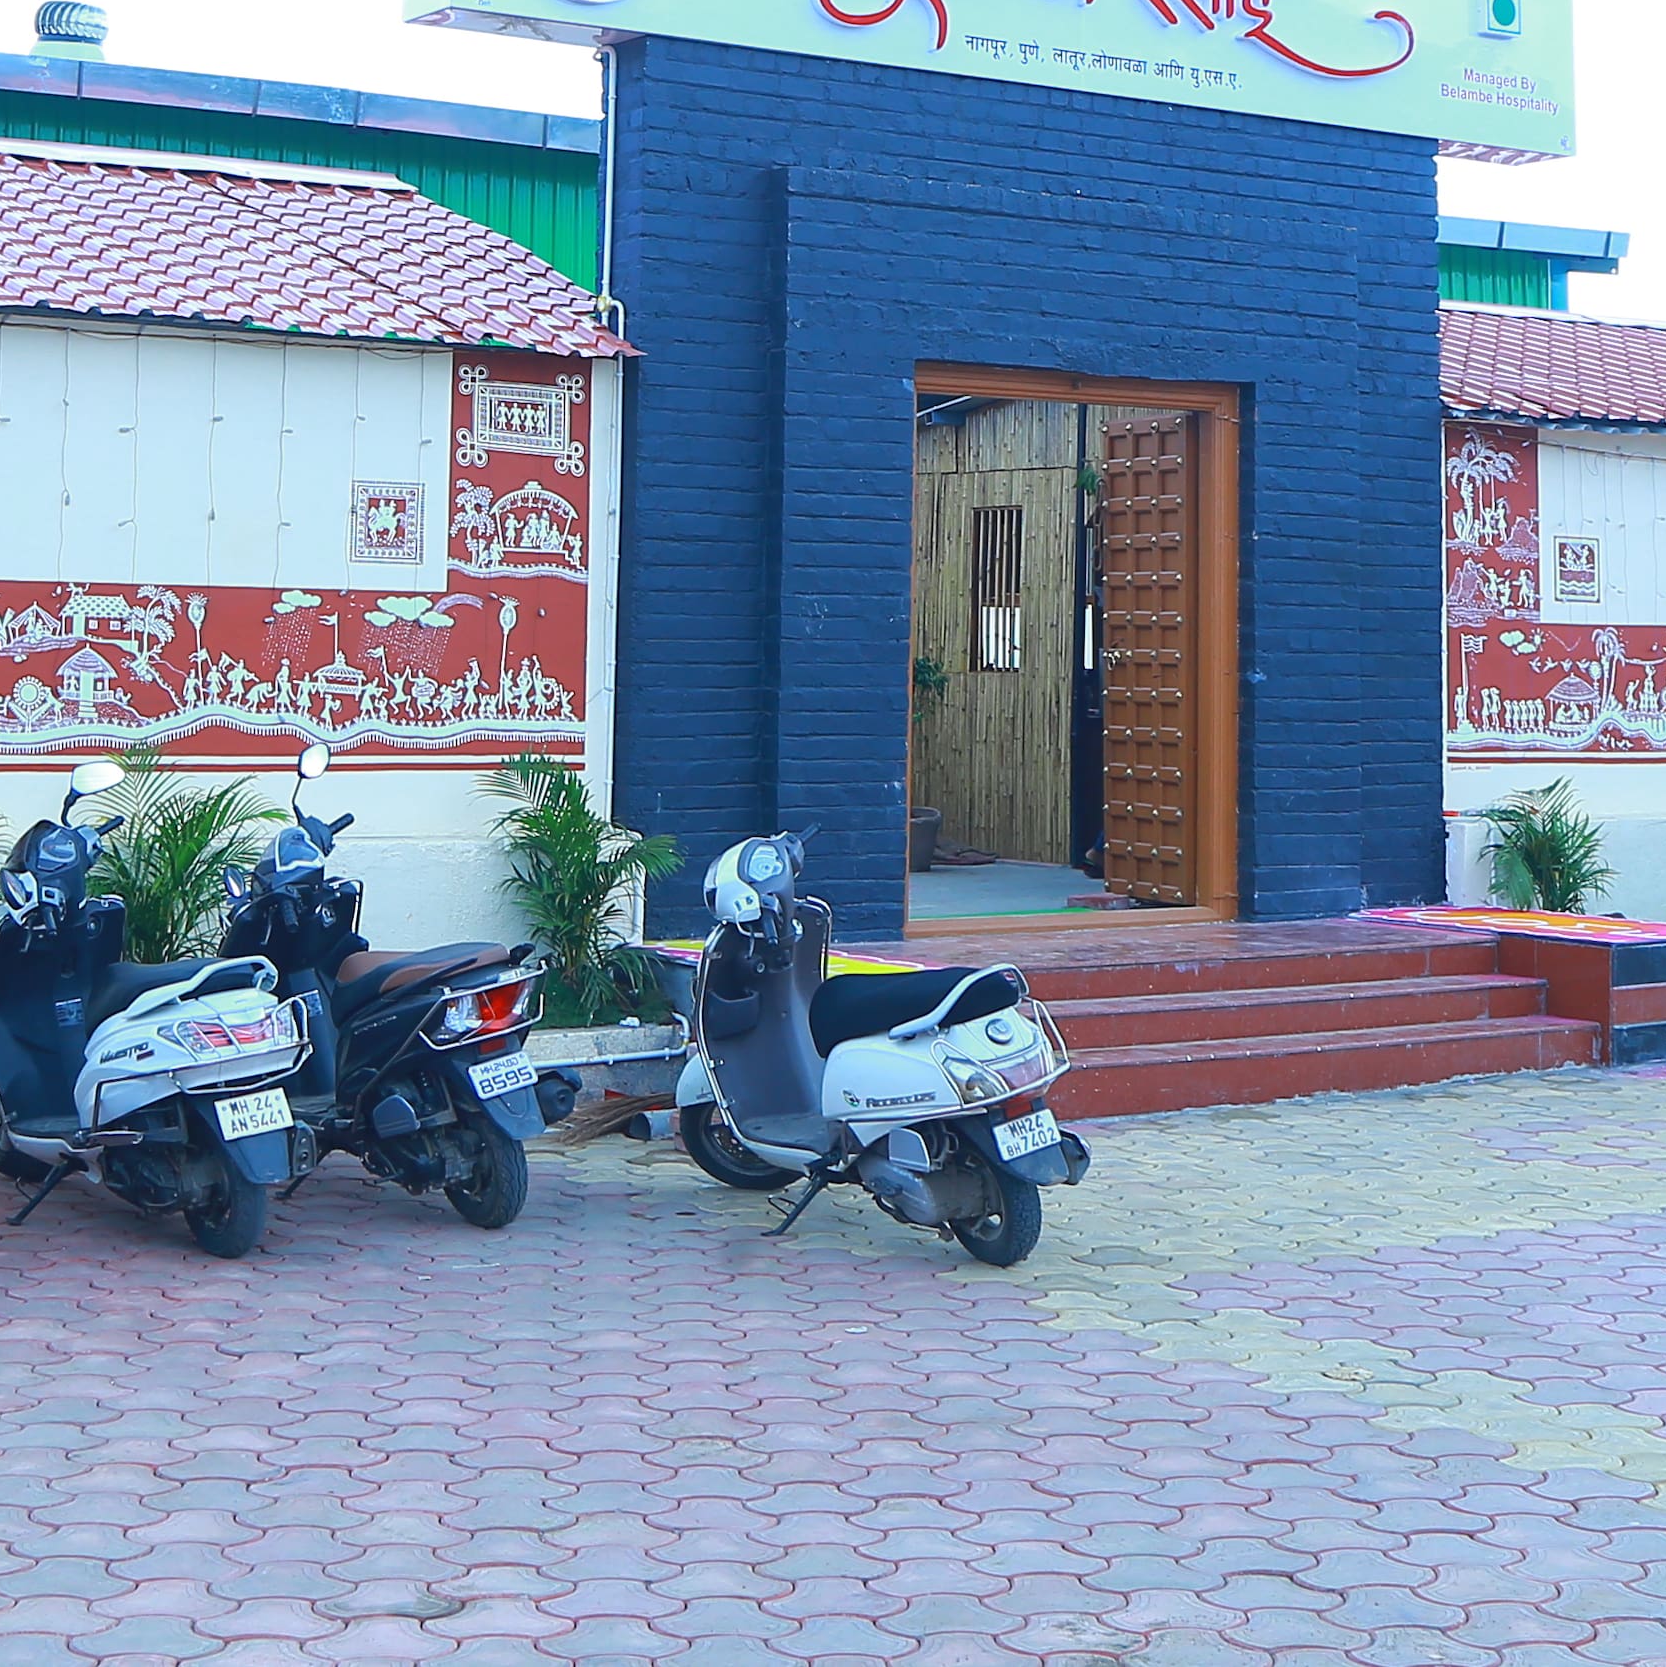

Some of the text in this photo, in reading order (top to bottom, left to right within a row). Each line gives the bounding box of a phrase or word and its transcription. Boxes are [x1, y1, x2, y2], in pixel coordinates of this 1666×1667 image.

[1153, 59, 1184, 81] आणि
[1463, 68, 1537, 94] Managed By
[1441, 83, 1559, 116] Belambe Hospitality
[479, 1065, 533, 1094] 8595
[229, 1094, 273, 1116] MH 24
